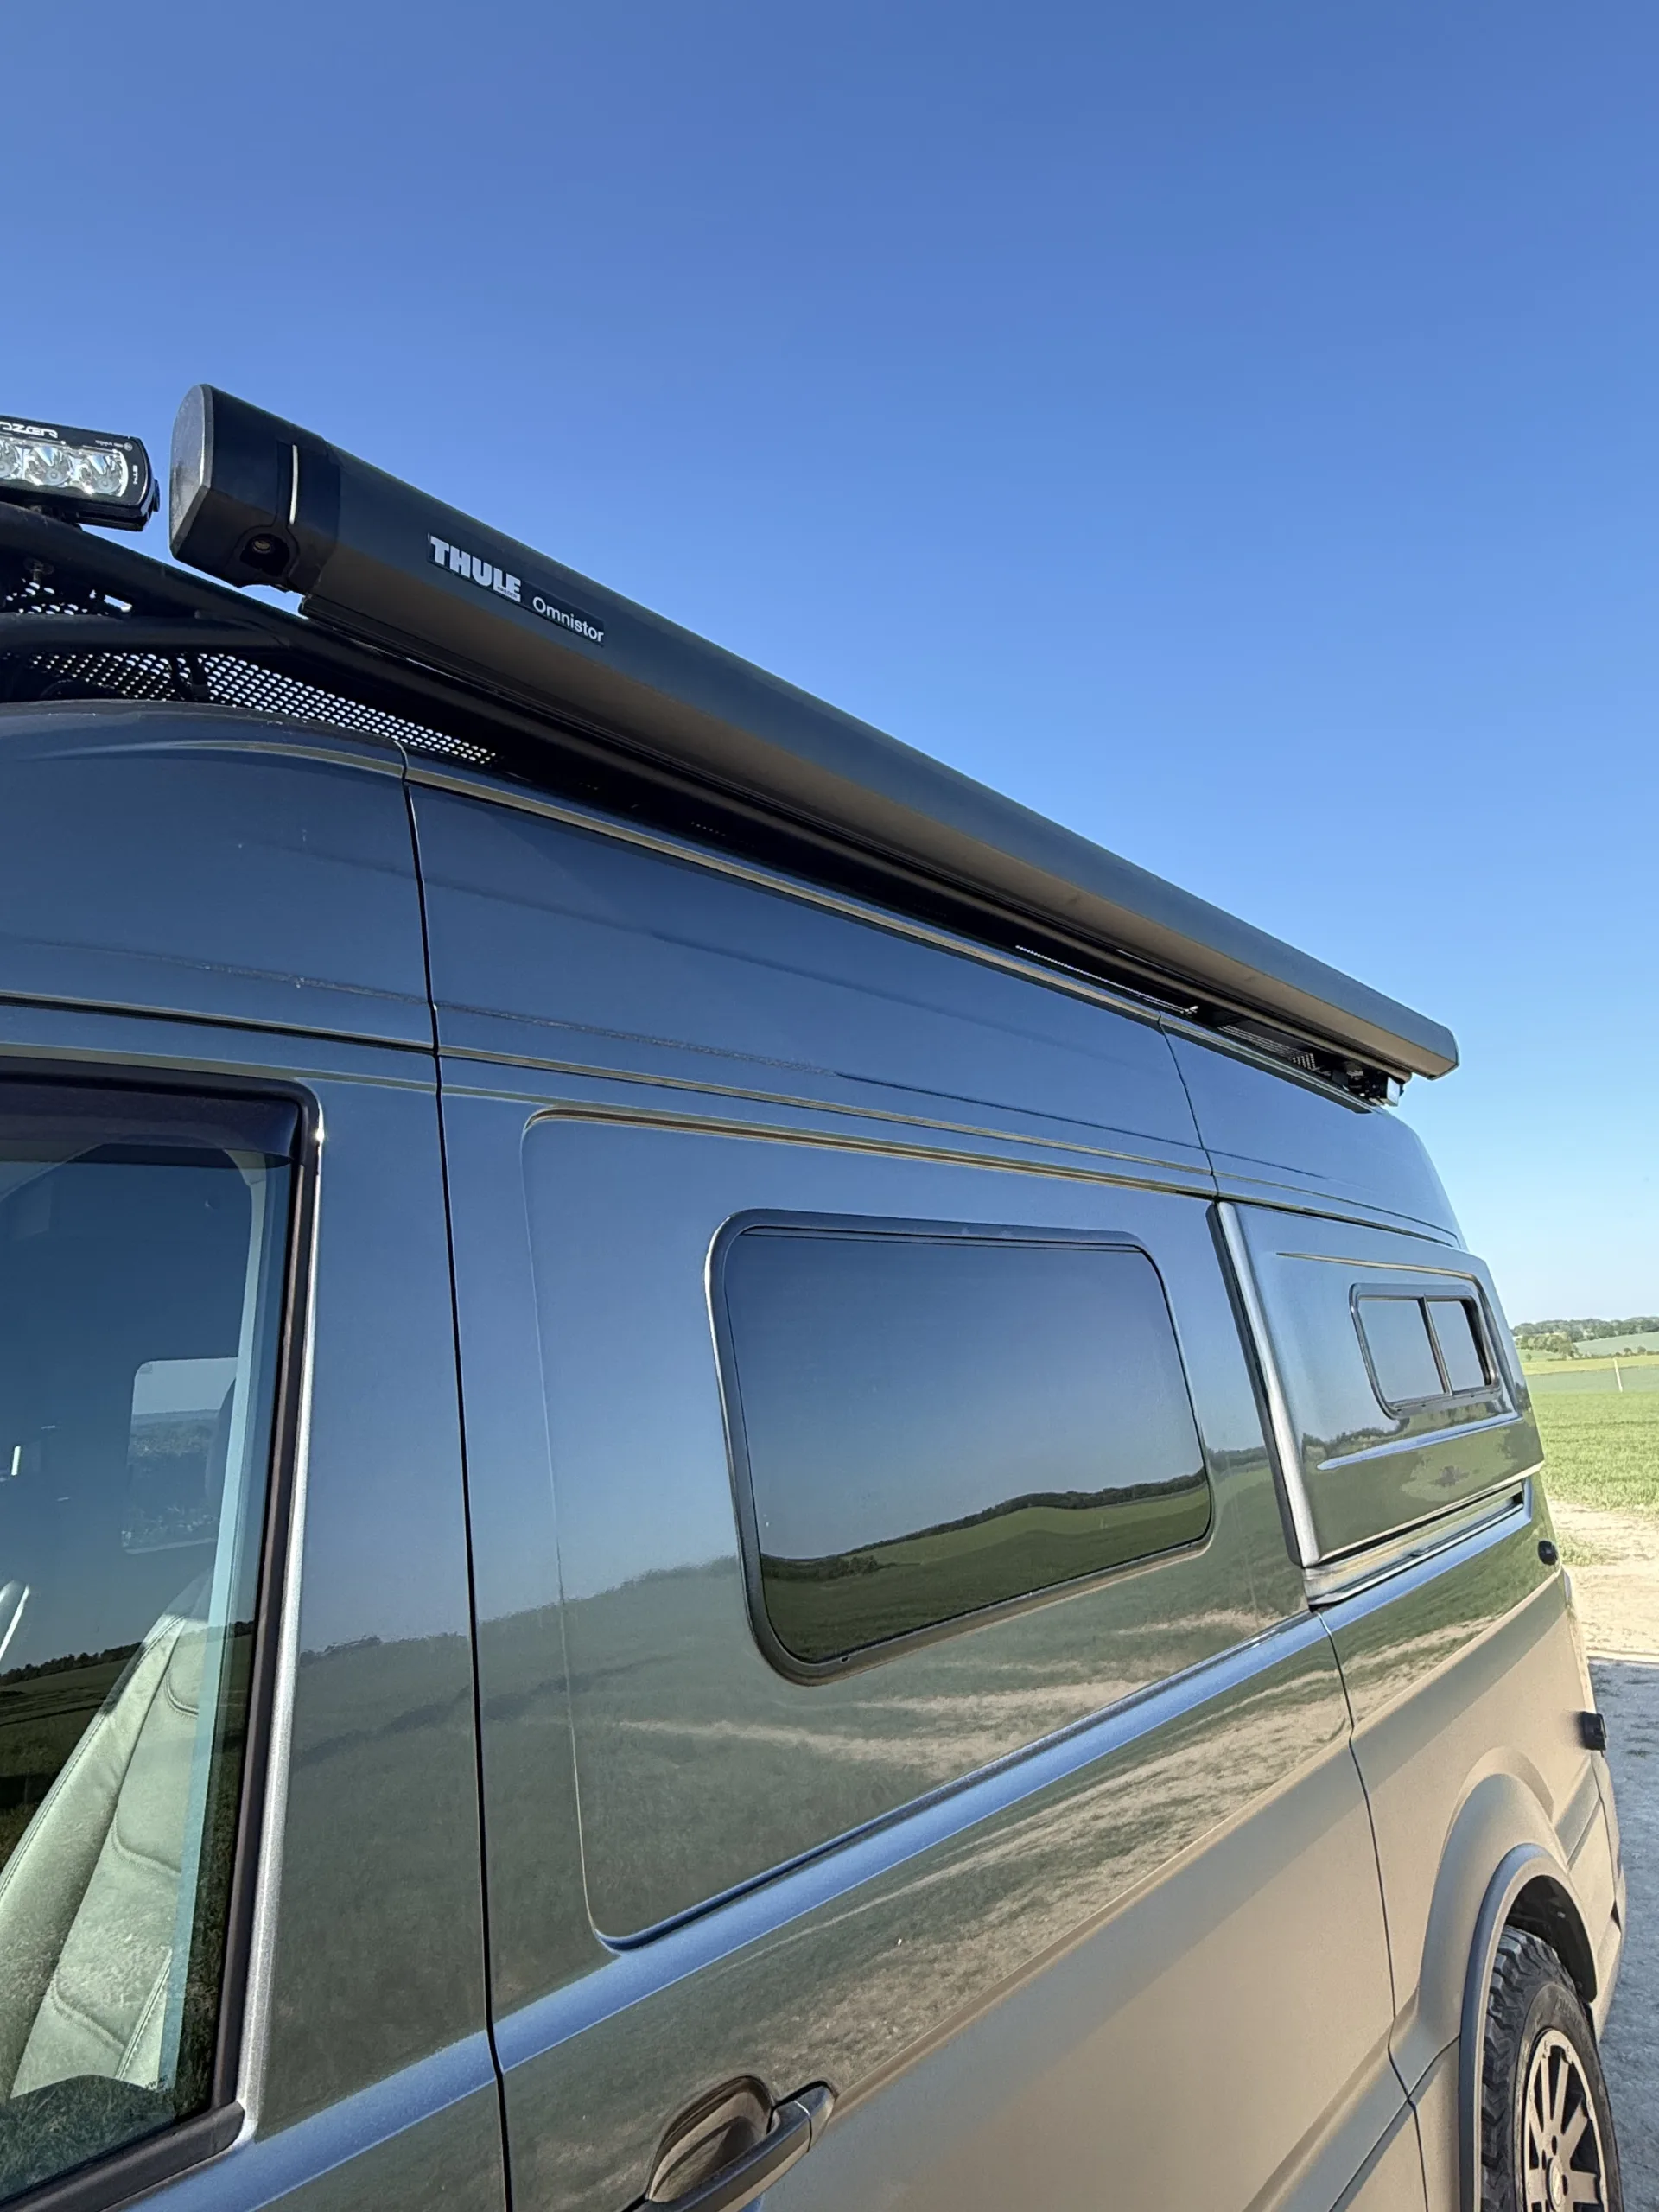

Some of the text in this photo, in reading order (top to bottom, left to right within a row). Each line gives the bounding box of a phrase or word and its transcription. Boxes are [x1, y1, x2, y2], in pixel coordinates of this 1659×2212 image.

[0, 422, 58, 438] AZER
[430, 536, 604, 642] THULE Omnistor
